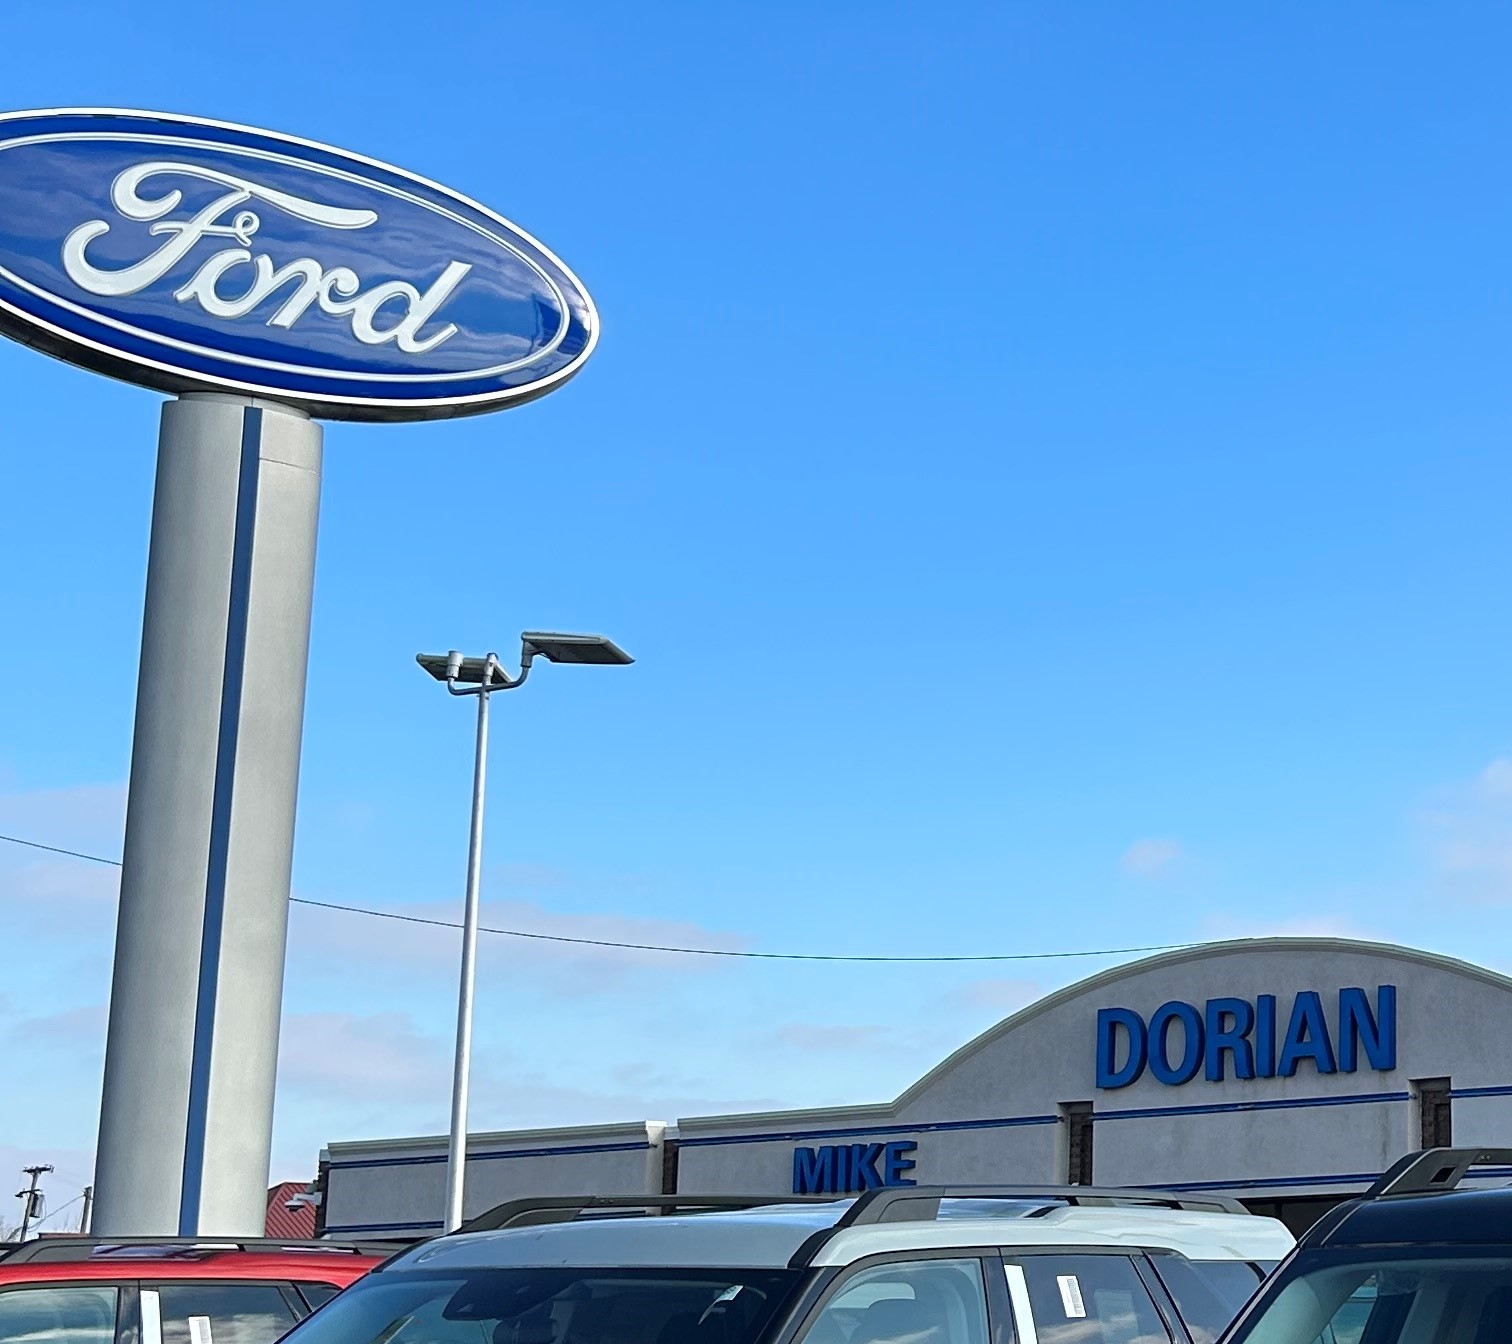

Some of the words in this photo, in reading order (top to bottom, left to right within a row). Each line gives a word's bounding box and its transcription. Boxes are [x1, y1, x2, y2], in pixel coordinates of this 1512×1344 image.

[60, 160, 473, 355] Ford
[1095, 984, 1397, 1090] DORIAN
[792, 1140, 918, 1195] MIKE
